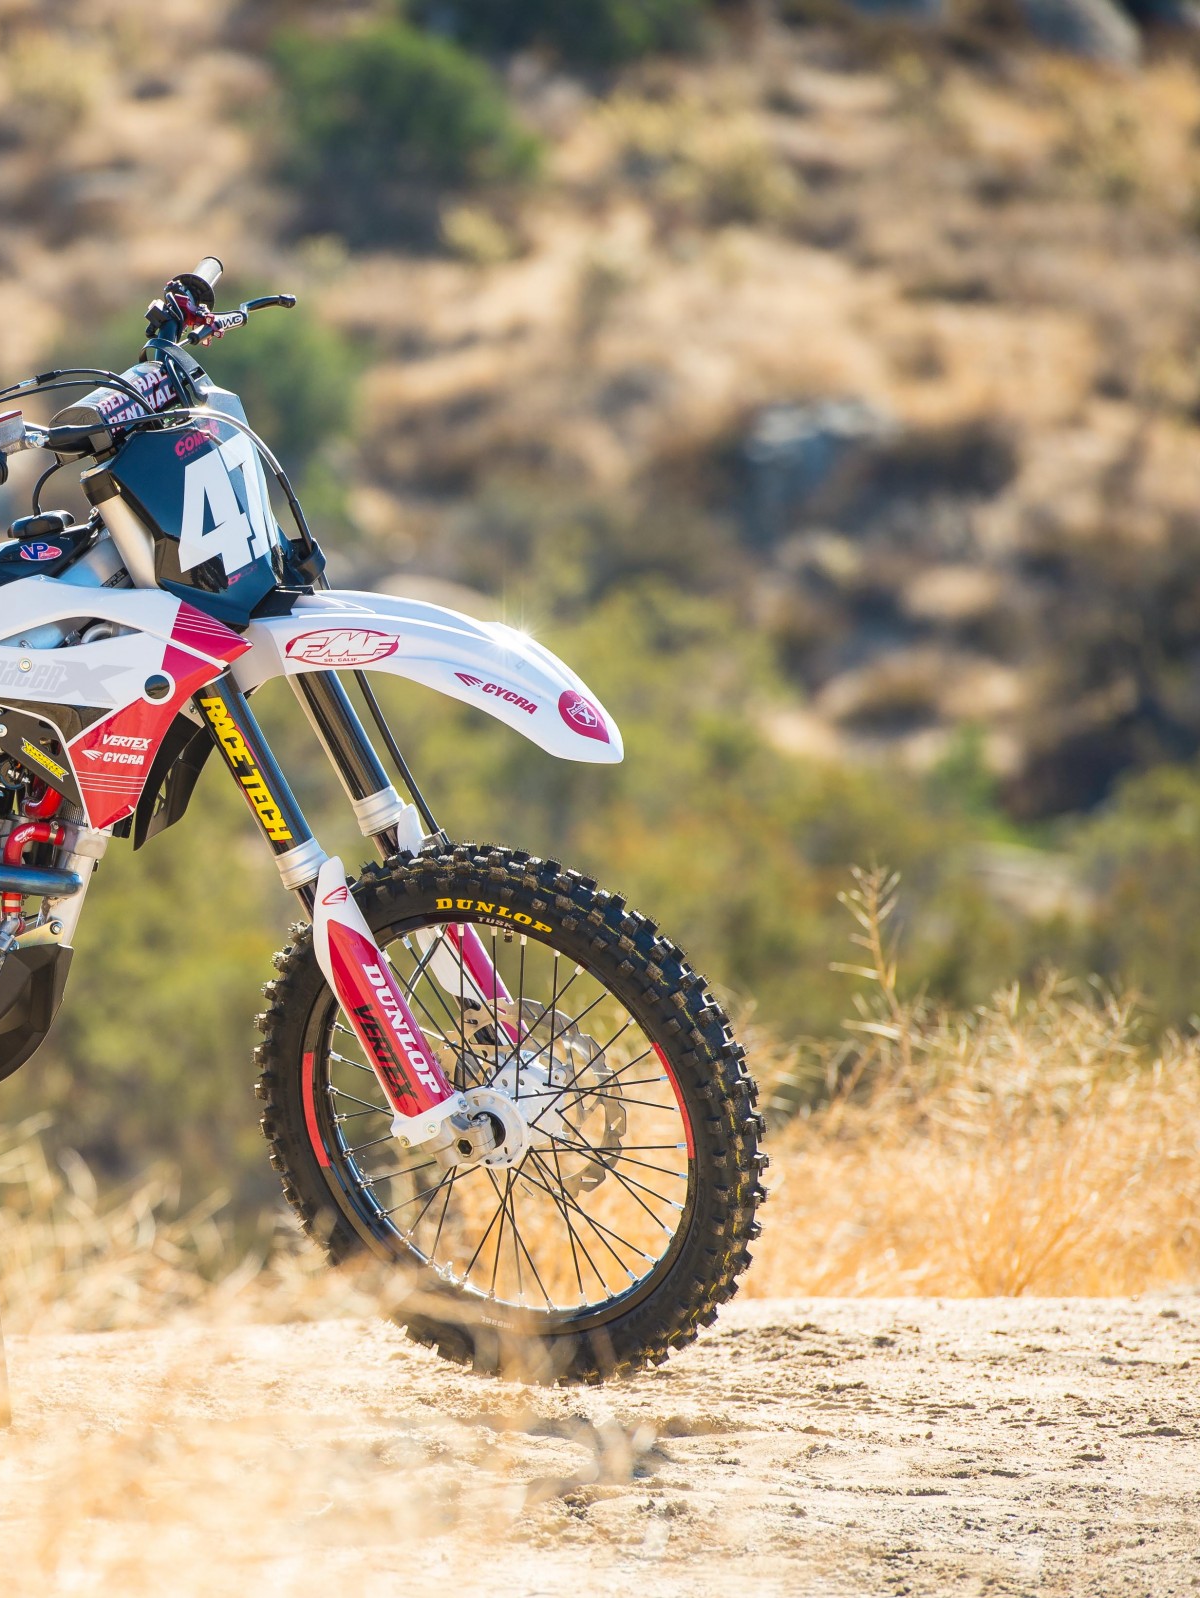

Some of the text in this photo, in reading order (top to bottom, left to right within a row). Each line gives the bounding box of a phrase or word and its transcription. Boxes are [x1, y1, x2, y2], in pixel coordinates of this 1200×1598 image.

[97, 368, 168, 415] RENHAL
[178, 431, 277, 577] 47
[21, 542, 49, 560] VP
[285, 631, 400, 658] FMF
[482, 682, 538, 715] CYCRA
[102, 734, 153, 749] VERTEX
[102, 752, 145, 765] CYCRA
[200, 697, 293, 840] RACE TECH
[436, 898, 553, 934] DUNLOP
[478, 916, 514, 929] TUSK
[362, 963, 441, 1094] DUNLOP
[353, 1003, 418, 1099] VERTEX
